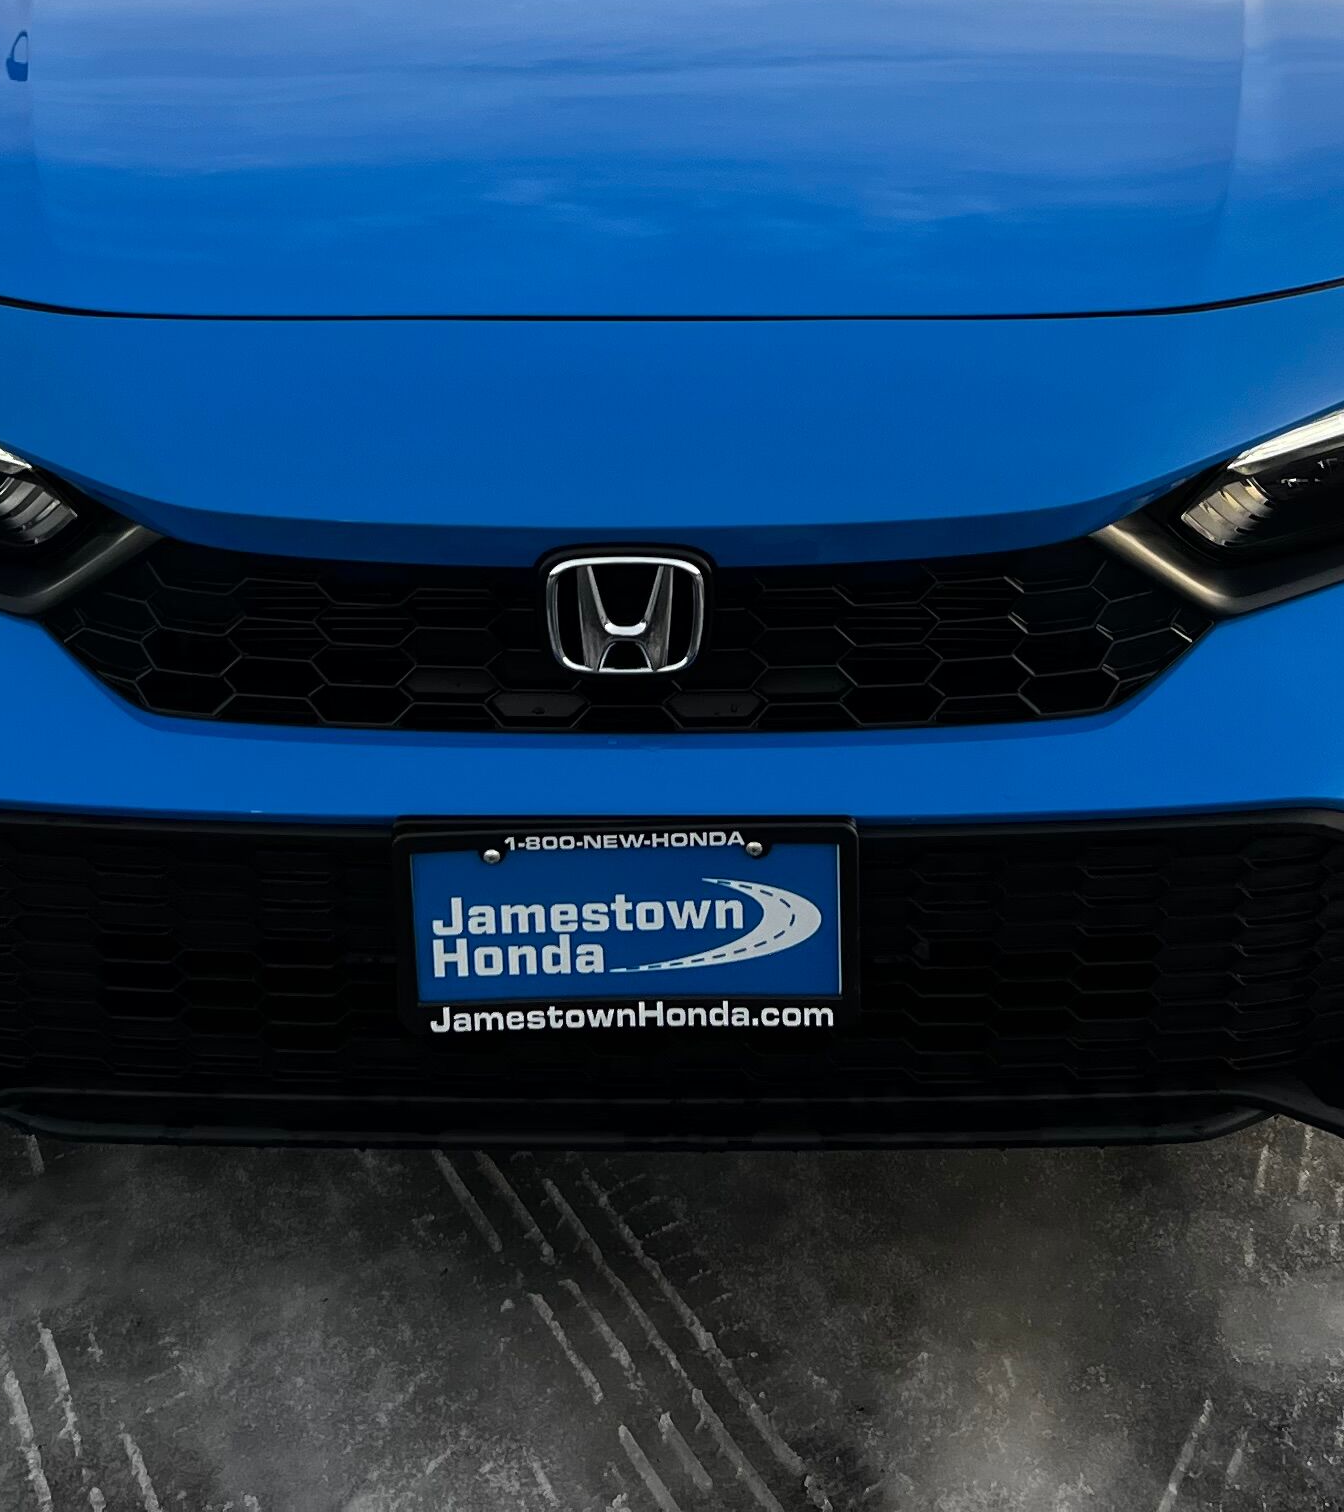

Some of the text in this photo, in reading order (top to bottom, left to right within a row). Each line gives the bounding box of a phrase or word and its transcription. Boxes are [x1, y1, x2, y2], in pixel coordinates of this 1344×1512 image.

[504, 830, 746, 852] 1-800-NEW-HONDA
[432, 894, 745, 936] Jamestown
[432, 935, 606, 978] Honda
[430, 1001, 835, 1034] JamestownHonda.com
